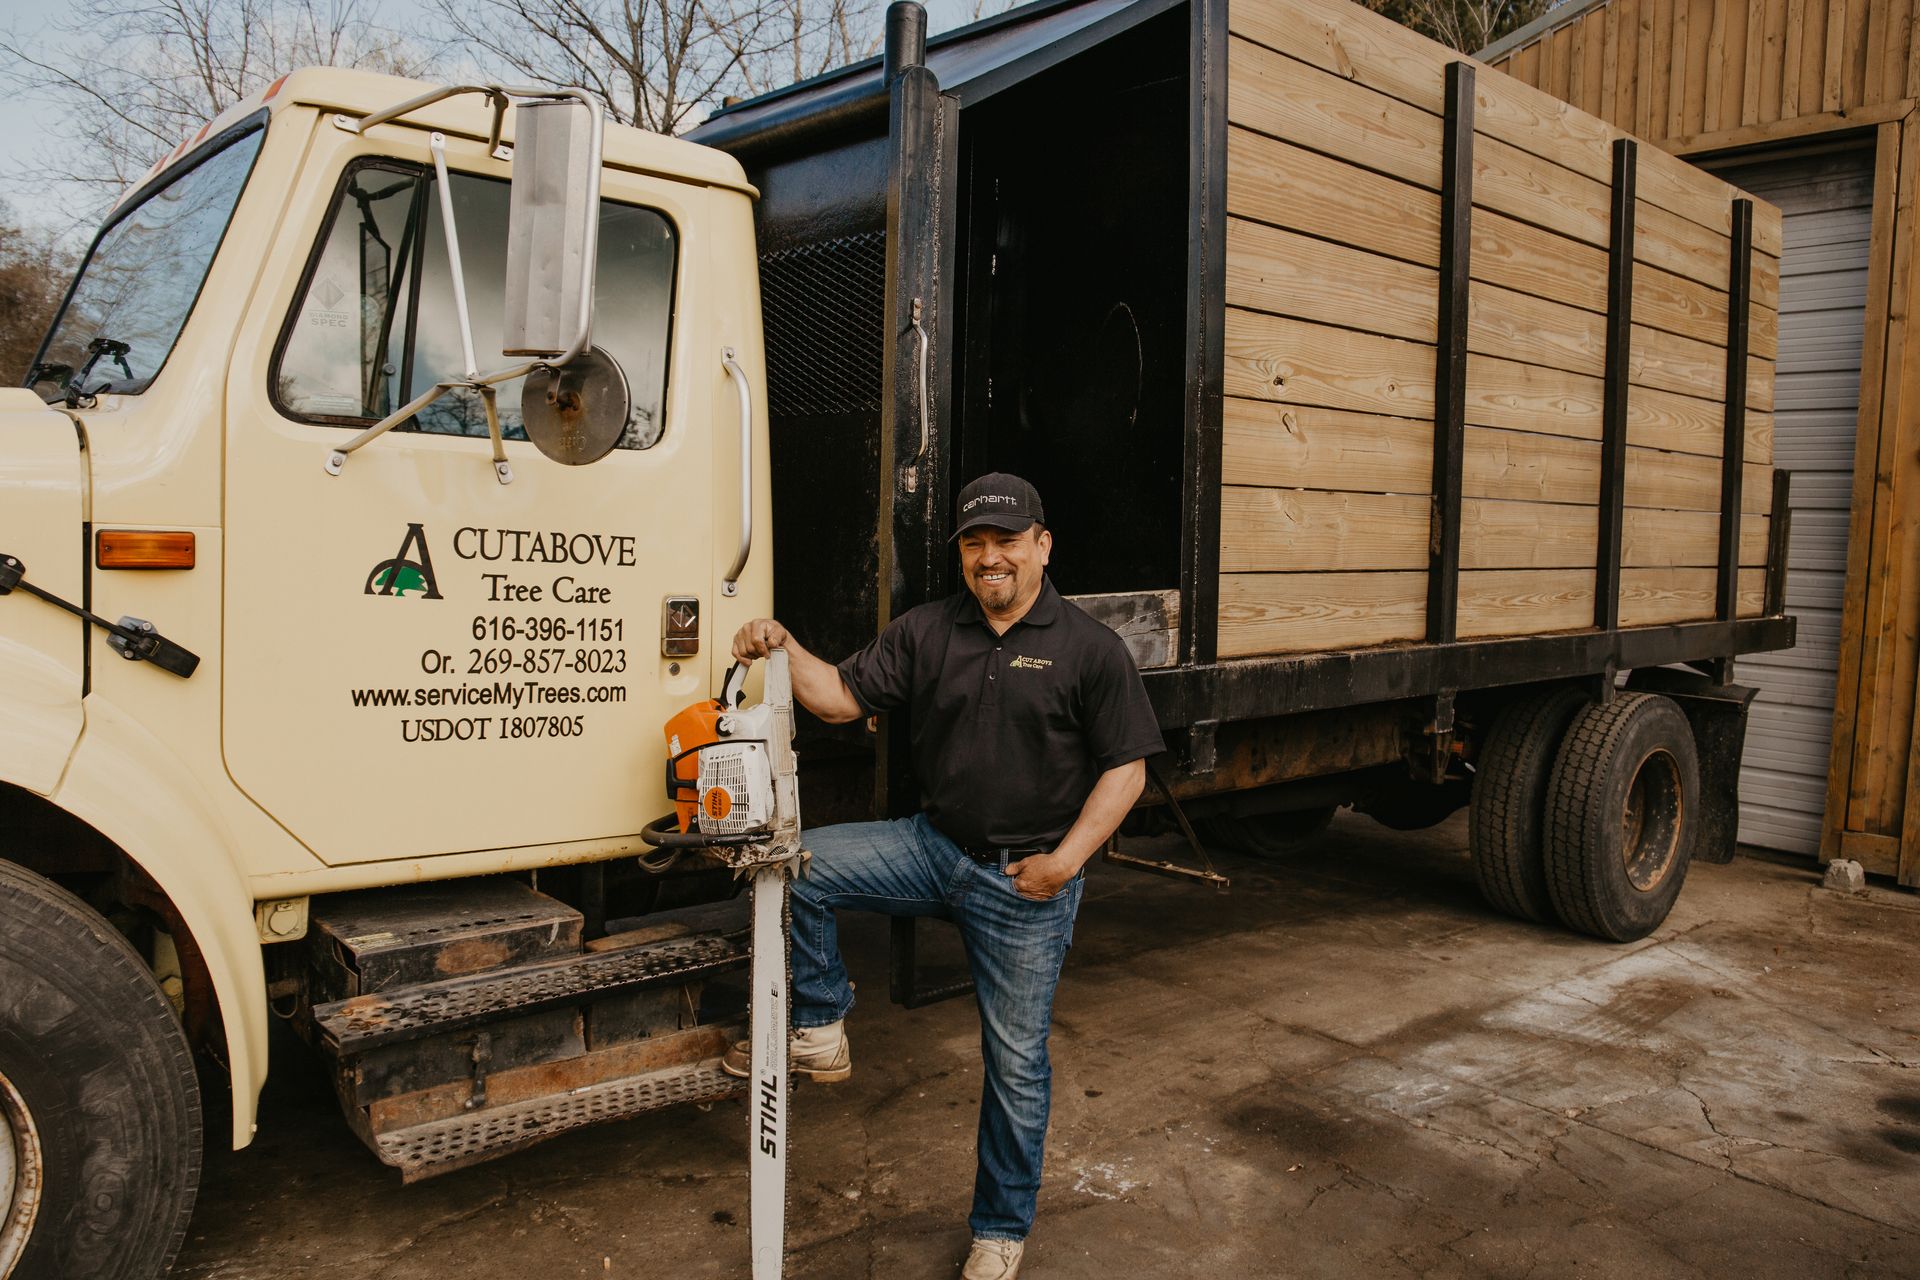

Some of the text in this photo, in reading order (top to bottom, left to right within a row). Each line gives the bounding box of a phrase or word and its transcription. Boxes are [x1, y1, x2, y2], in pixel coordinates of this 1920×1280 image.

[311, 318, 347, 328] SPEC
[962, 495, 1017, 512] carhartt
[453, 526, 637, 567] CUTABOVE
[480, 573, 612, 604] Tree Care
[472, 616, 623, 642] 616-396-1151
[421, 648, 627, 675] Or. 269-857-8023
[351, 681, 627, 710] www.serviceMyTrees.com
[400, 715, 585, 743] USDOT 1807805
[761, 1074, 778, 1159] STIHL
